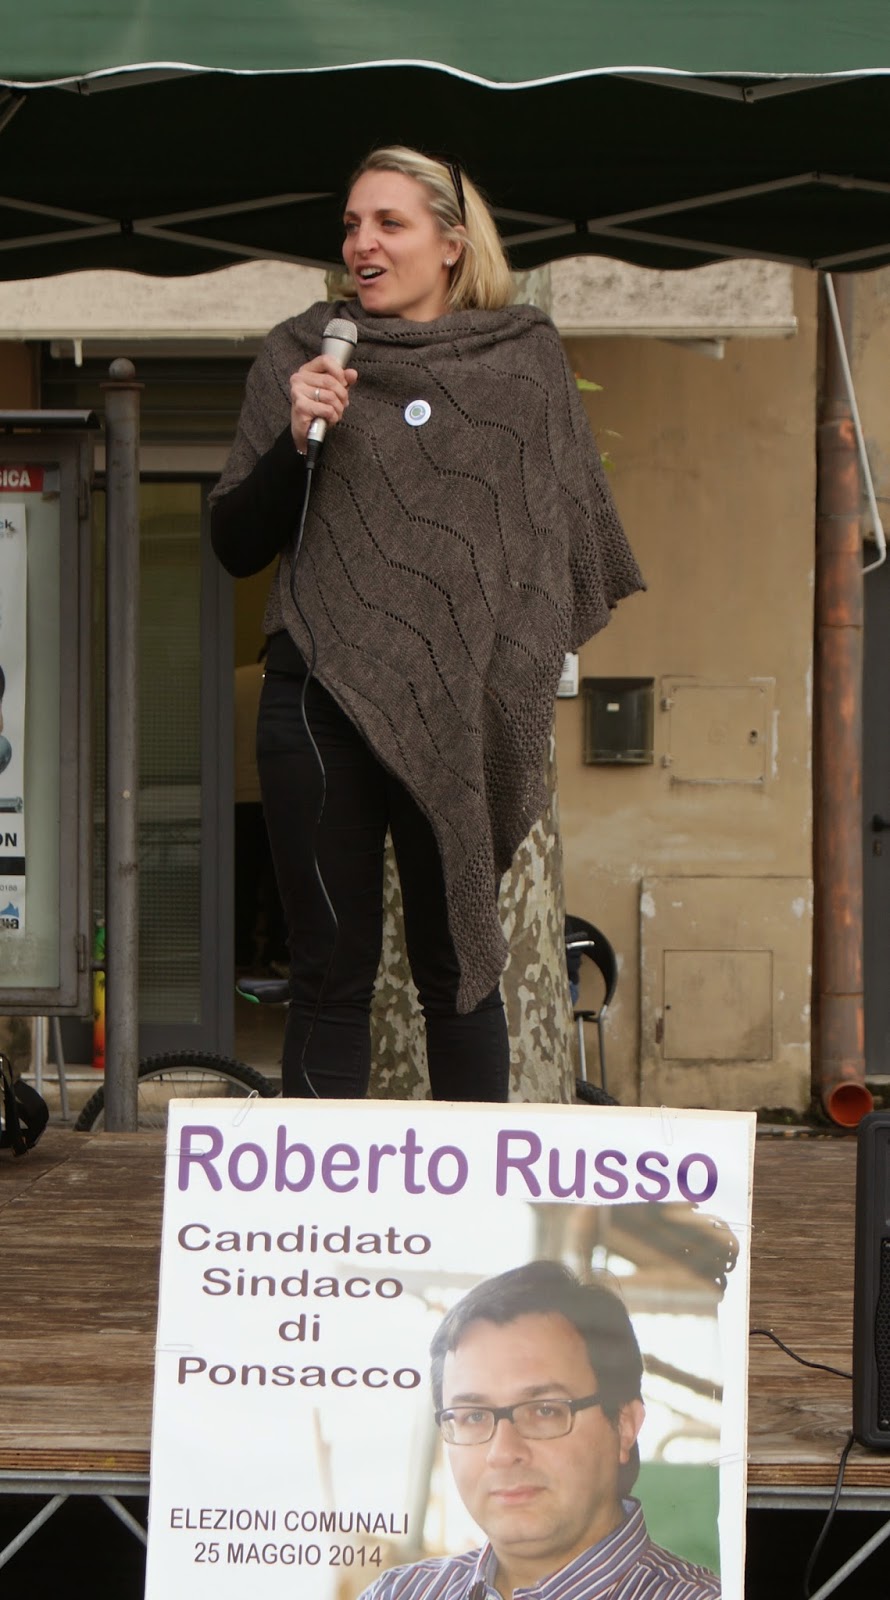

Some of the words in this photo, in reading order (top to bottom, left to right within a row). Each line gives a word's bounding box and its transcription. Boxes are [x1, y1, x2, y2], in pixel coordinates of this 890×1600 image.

[0, 470, 31, 487] ICA
[178, 1125, 469, 1195] Roberto
[496, 1130, 718, 1202] Russo
[177, 1223, 432, 1256] Candidato
[201, 1267, 404, 1299] Sindaco
[278, 1313, 321, 1343] di
[178, 1356, 422, 1389] Ponsacco
[170, 1508, 277, 1532] ELEZIONI
[284, 1510, 409, 1535] COMUNALI
[194, 1542, 220, 1564] 25
[227, 1543, 322, 1567] MAGGIO
[329, 1545, 383, 1568] 2014
